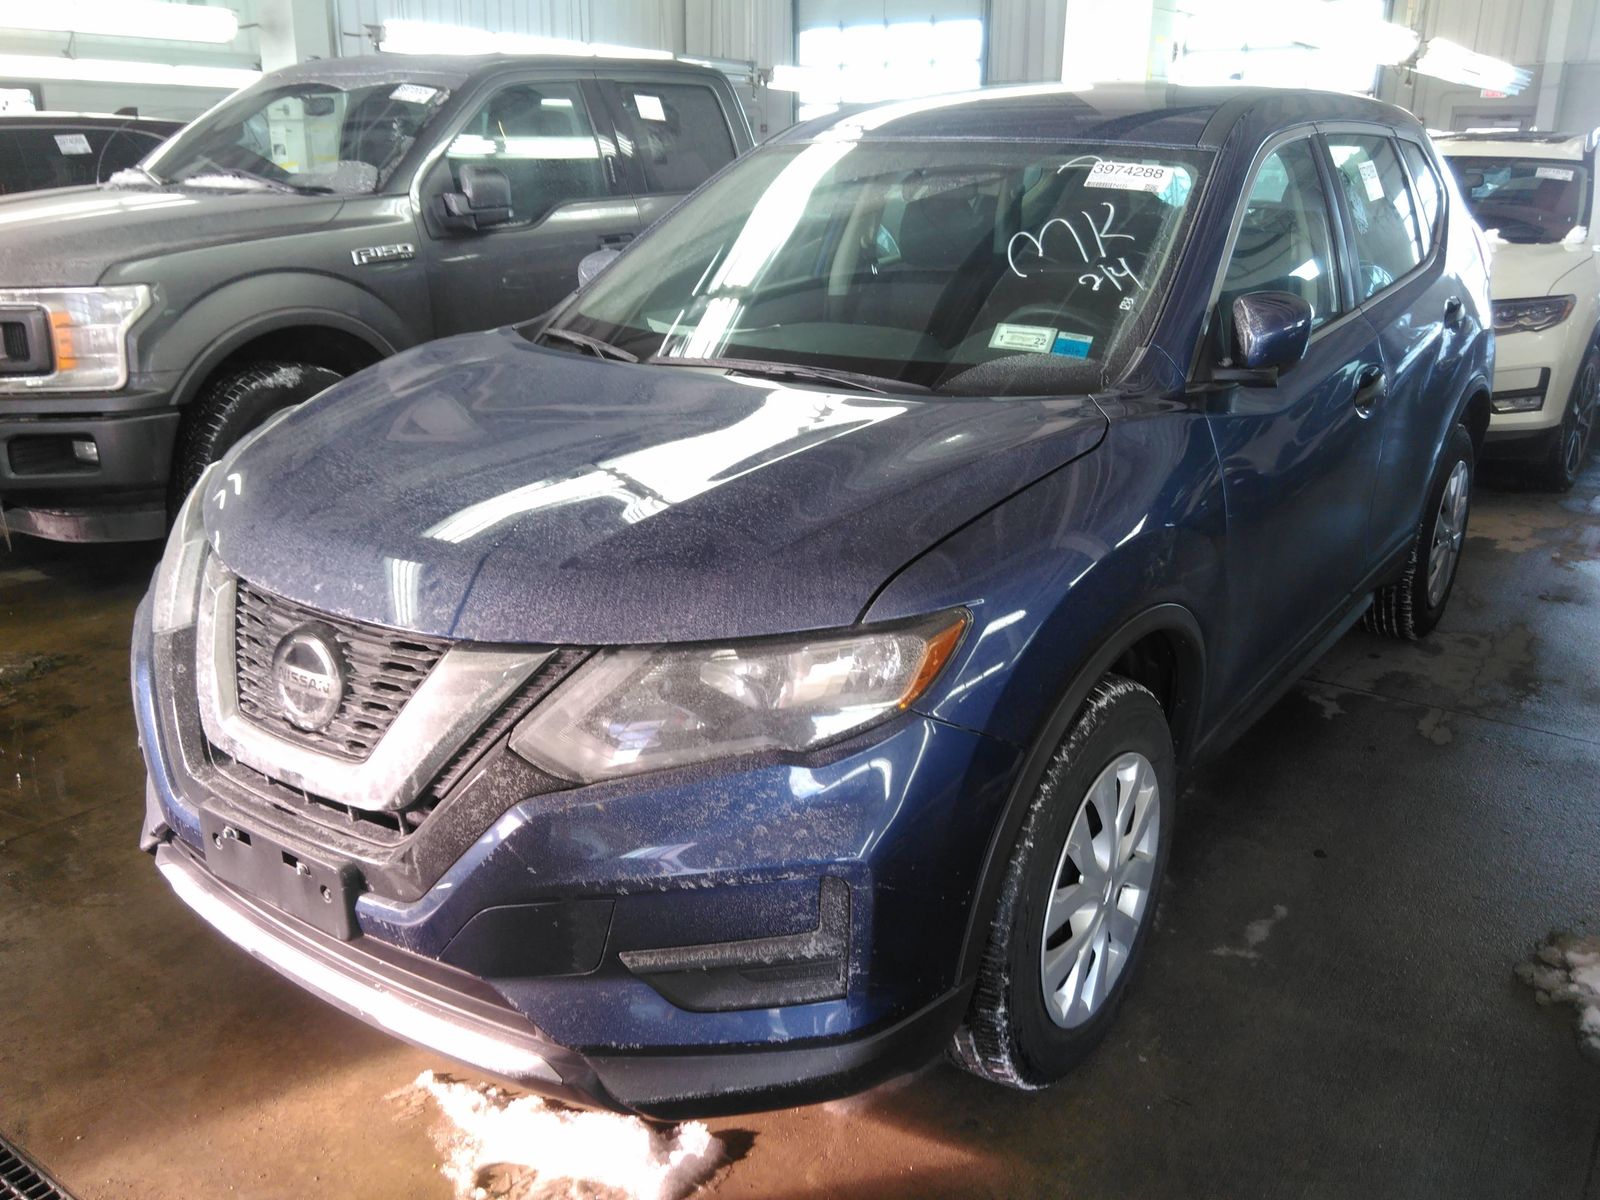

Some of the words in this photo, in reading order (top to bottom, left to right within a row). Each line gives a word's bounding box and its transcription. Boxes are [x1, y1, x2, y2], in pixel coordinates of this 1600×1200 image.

[1093, 163, 1165, 179] 3974288
[1034, 337, 1047, 346] 22
[278, 665, 331, 695] NISSAN
